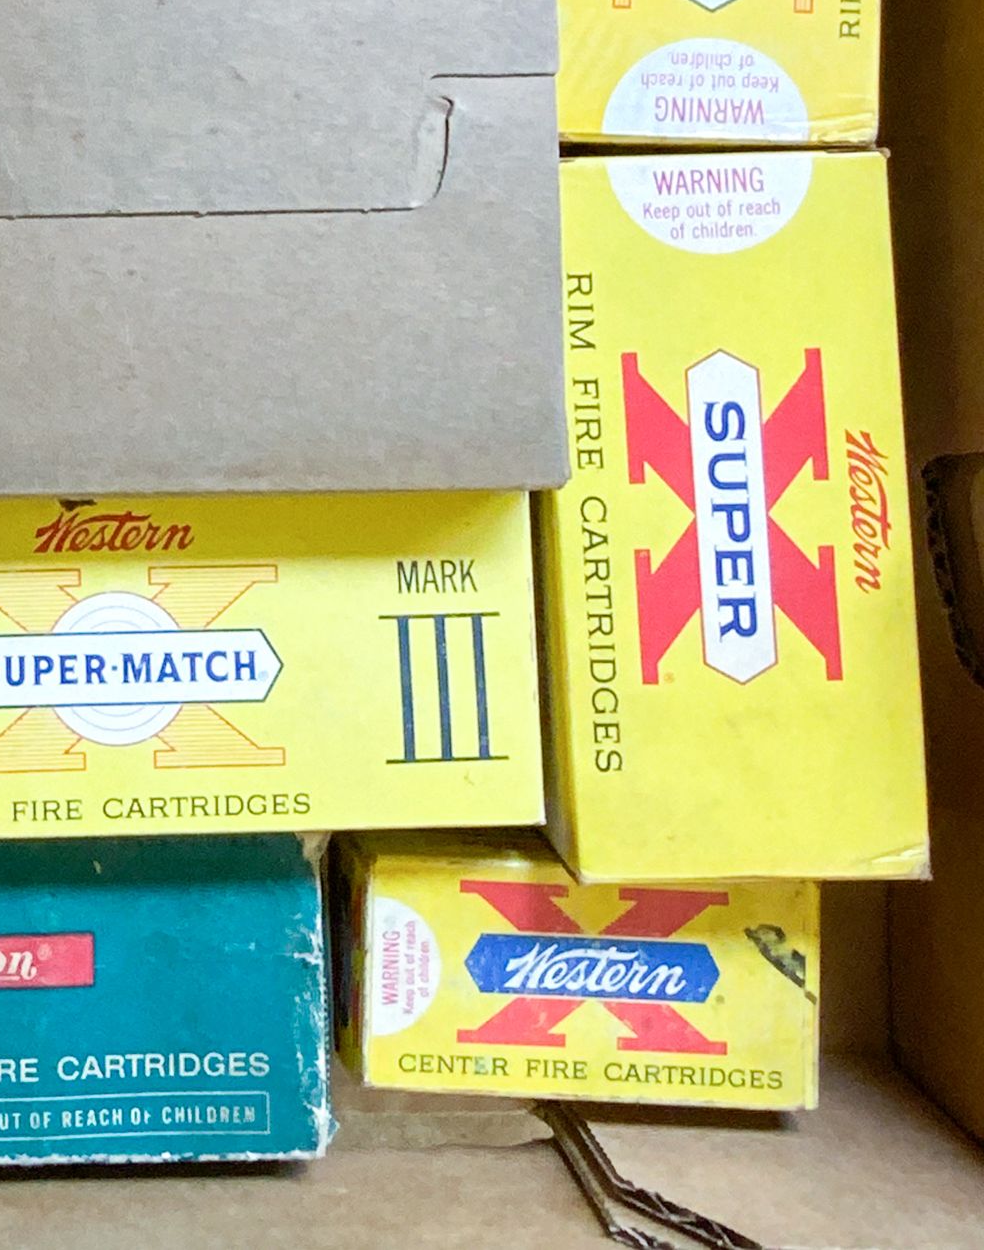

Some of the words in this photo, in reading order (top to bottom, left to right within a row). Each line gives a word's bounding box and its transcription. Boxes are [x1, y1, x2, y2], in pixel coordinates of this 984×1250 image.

[738, 53, 755, 70] of
[640, 72, 683, 89] reach
[689, 73, 705, 91] of
[710, 73, 736, 91] out
[742, 73, 780, 93] Keep
[654, 96, 765, 125] WARNING
[652, 166, 764, 196] WARNING
[642, 202, 680, 220] Keep
[686, 201, 711, 219] out
[717, 200, 732, 217] of
[739, 198, 781, 216] reach
[670, 223, 685, 240] of
[566, 271, 597, 351] RIM
[572, 377, 604, 471] FIRE
[703, 400, 758, 643] SUPER
[845, 429, 891, 595] Western
[34, 511, 196, 553] Western
[397, 559, 478, 595] MARK
[579, 496, 622, 774] CARTRIDGES
[379, 611, 509, 765] III
[11, 798, 84, 822] FIRE
[102, 793, 312, 821] CARTRIDGES
[381, 930, 401, 1006] WARNING
[504, 942, 686, 996] Western
[56, 1052, 270, 1080] CARTRIDGES
[398, 1053, 509, 1077] CENTER
[526, 1058, 588, 1080] FIRE
[604, 1062, 784, 1090] CARTRIDGES
[29, 1111, 52, 1130] OF
[61, 1109, 123, 1128] REACH
[160, 1105, 256, 1125] CHILDREN
